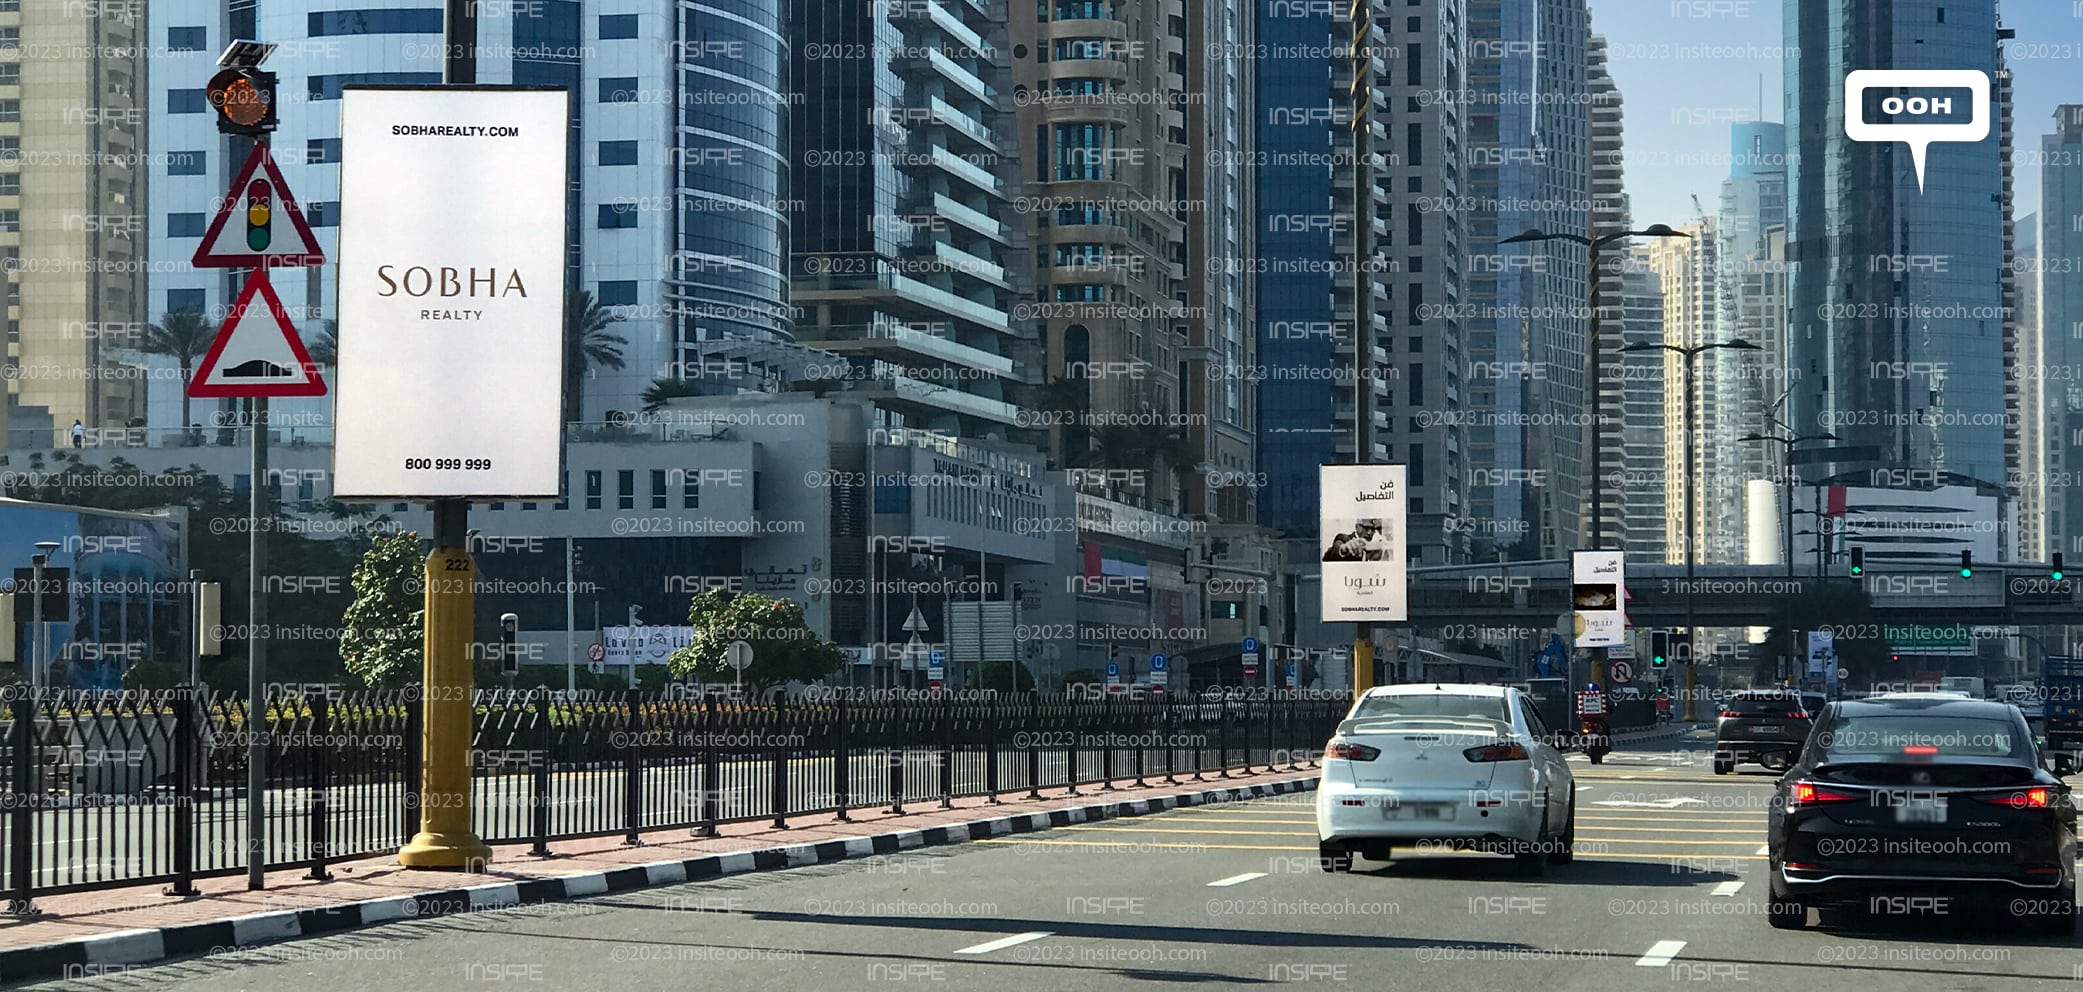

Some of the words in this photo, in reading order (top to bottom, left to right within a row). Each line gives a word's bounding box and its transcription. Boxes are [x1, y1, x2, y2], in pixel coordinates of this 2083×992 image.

[391, 124, 519, 138] SOBHAREALTY.COM
[377, 264, 528, 299] SOBHA
[420, 309, 484, 321] REALTY
[405, 457, 432, 471] 800
[435, 457, 462, 471] 999
[464, 457, 492, 471] 999
[1380, 480, 1394, 490] فن
[1355, 490, 1394, 502] التفاصيل
[445, 559, 470, 572] 222
